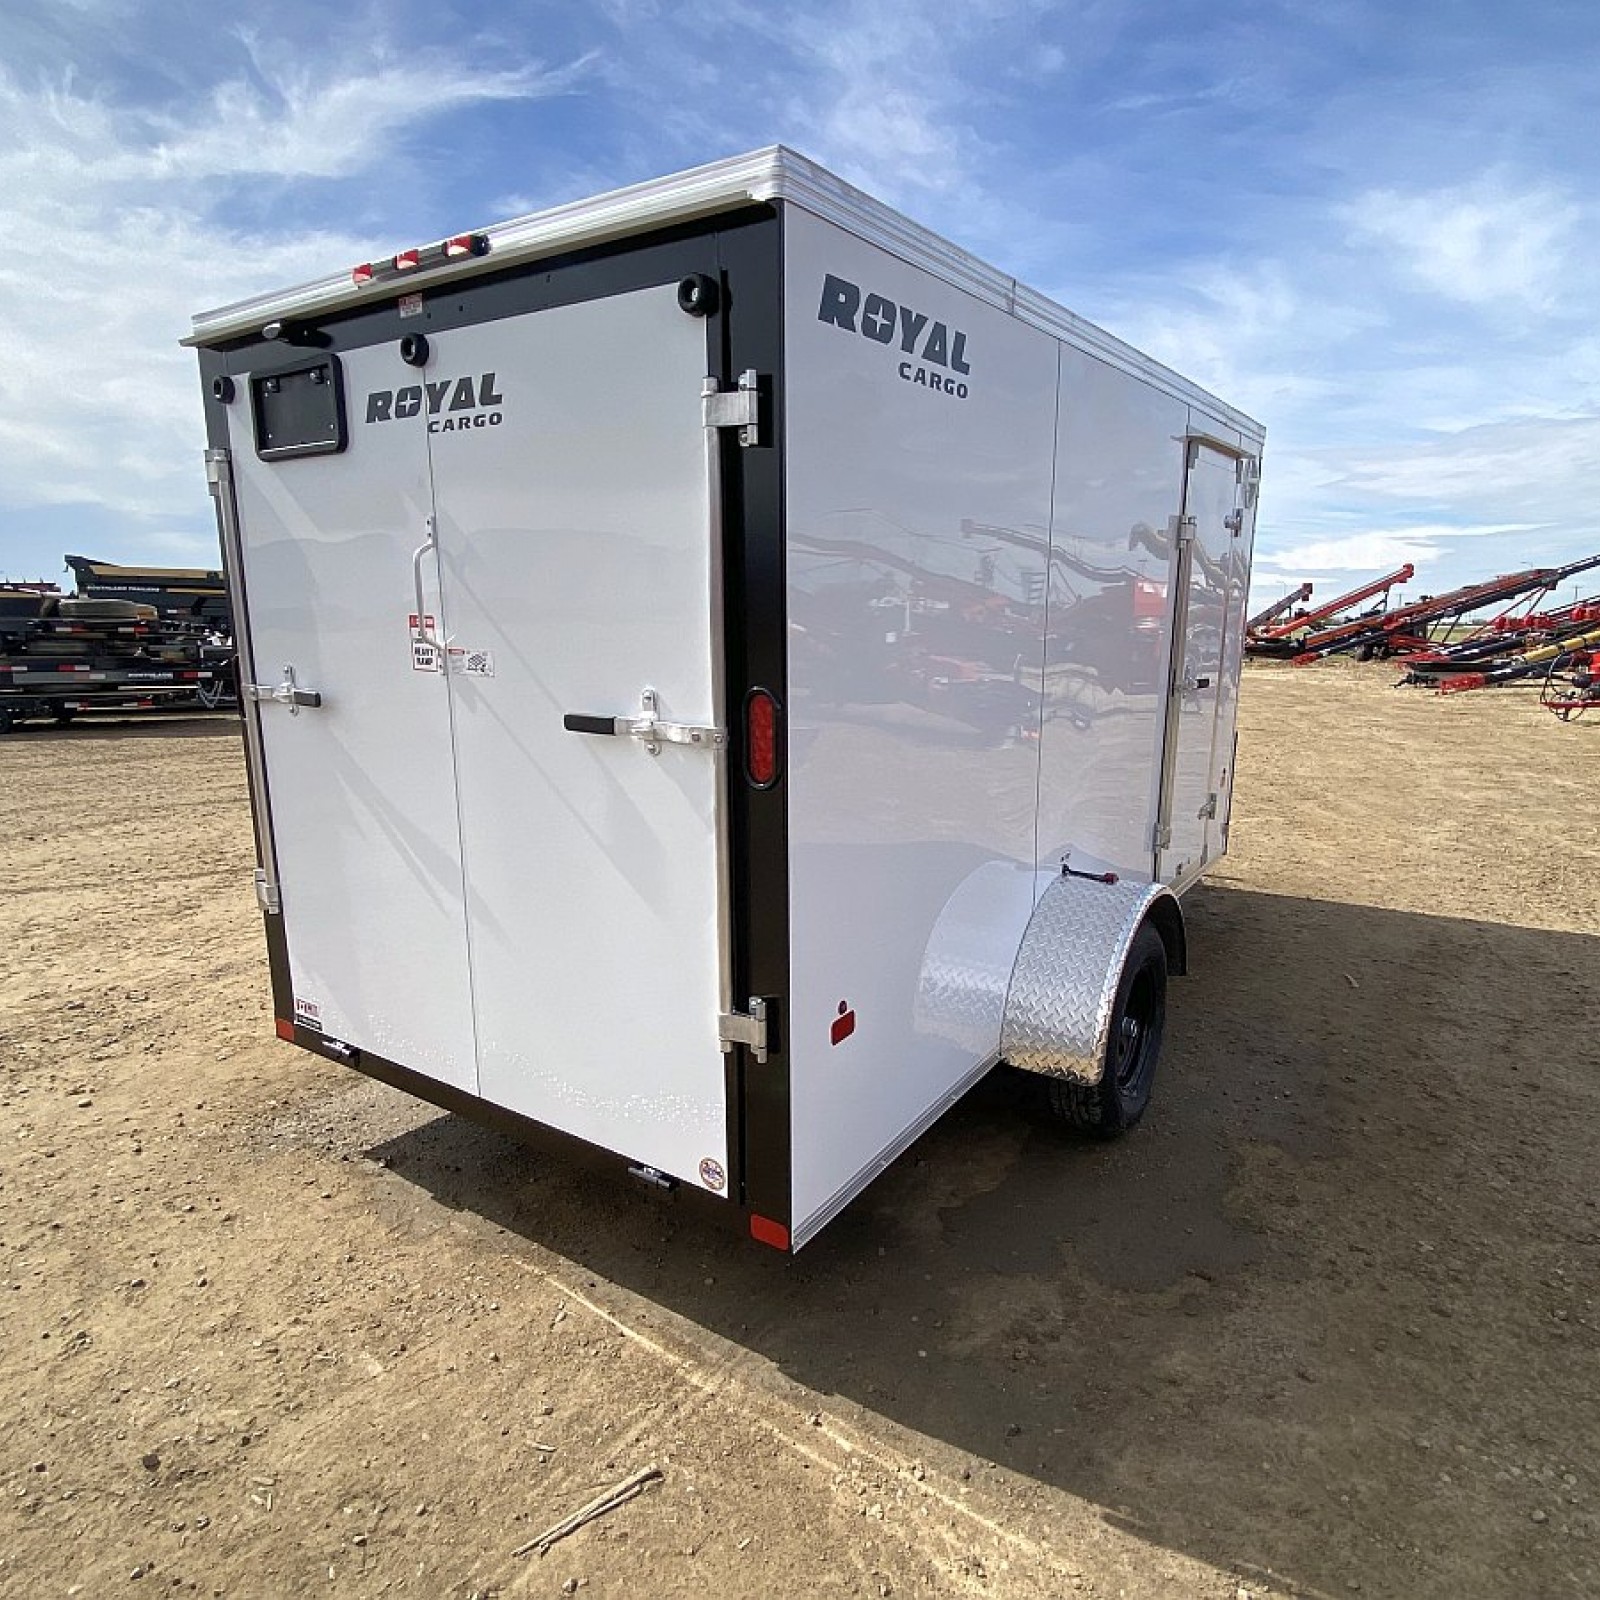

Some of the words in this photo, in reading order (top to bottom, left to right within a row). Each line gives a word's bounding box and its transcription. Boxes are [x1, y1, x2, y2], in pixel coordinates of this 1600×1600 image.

[817, 273, 970, 376] ROYAL
[365, 372, 503, 424] ROYAL
[899, 362, 969, 399] CARGO
[428, 412, 503, 433] CARGO
